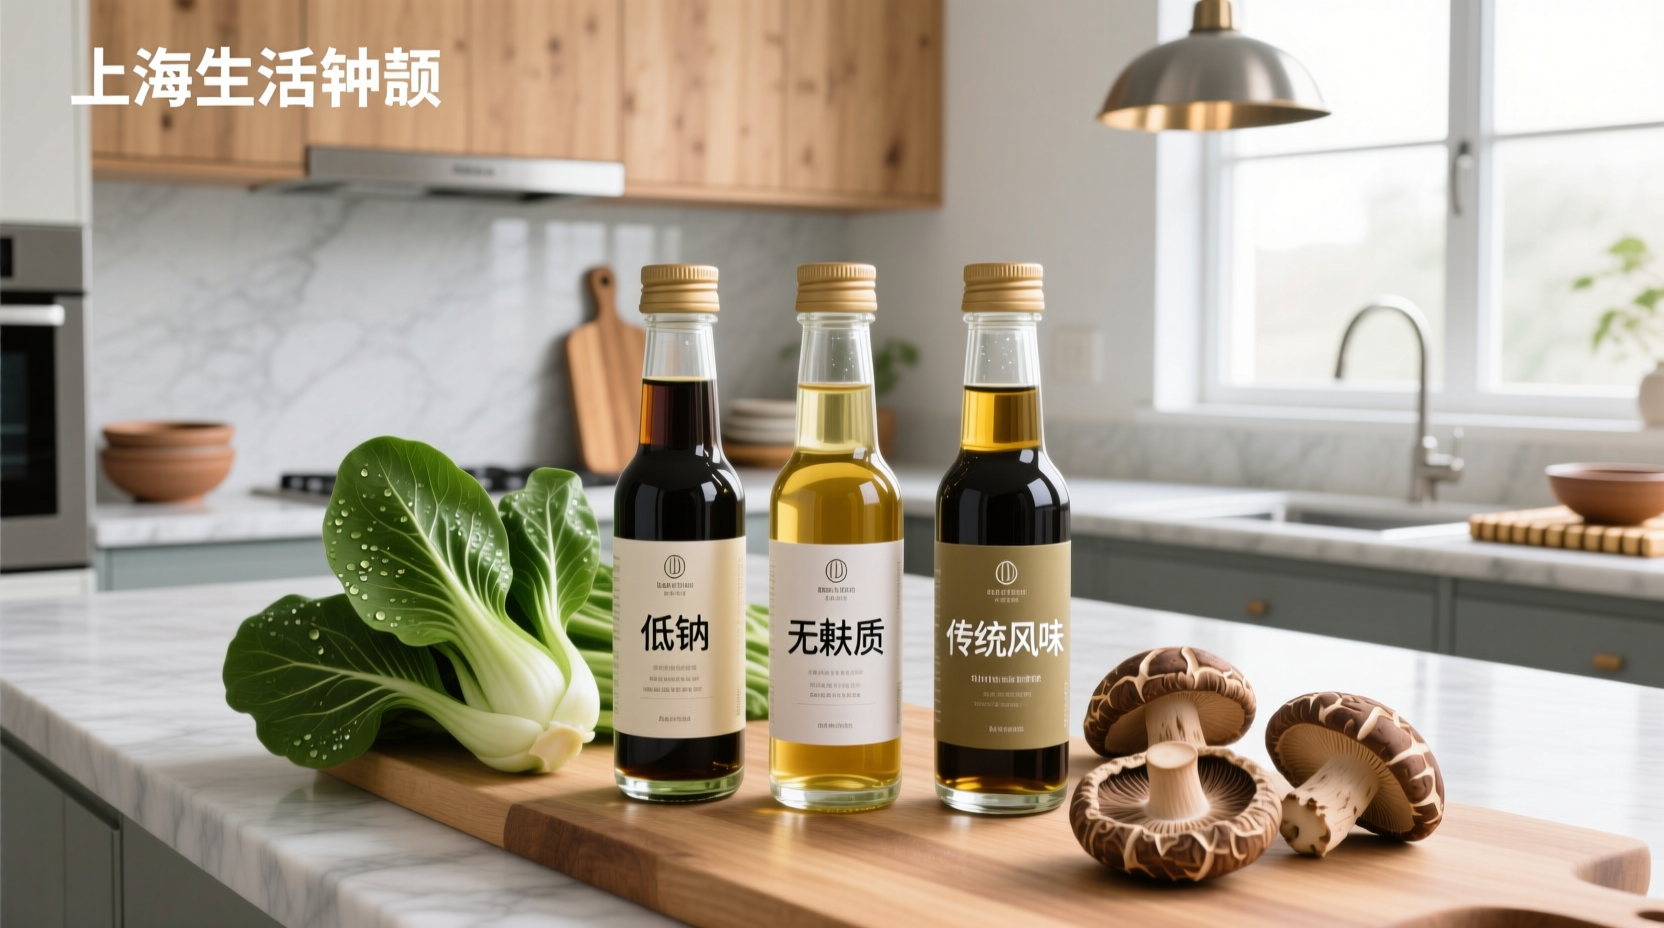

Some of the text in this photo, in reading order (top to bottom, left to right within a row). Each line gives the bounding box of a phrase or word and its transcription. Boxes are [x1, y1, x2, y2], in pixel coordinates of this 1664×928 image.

[640, 613, 709, 652] 低钠
[946, 618, 1064, 657] 传统风味
